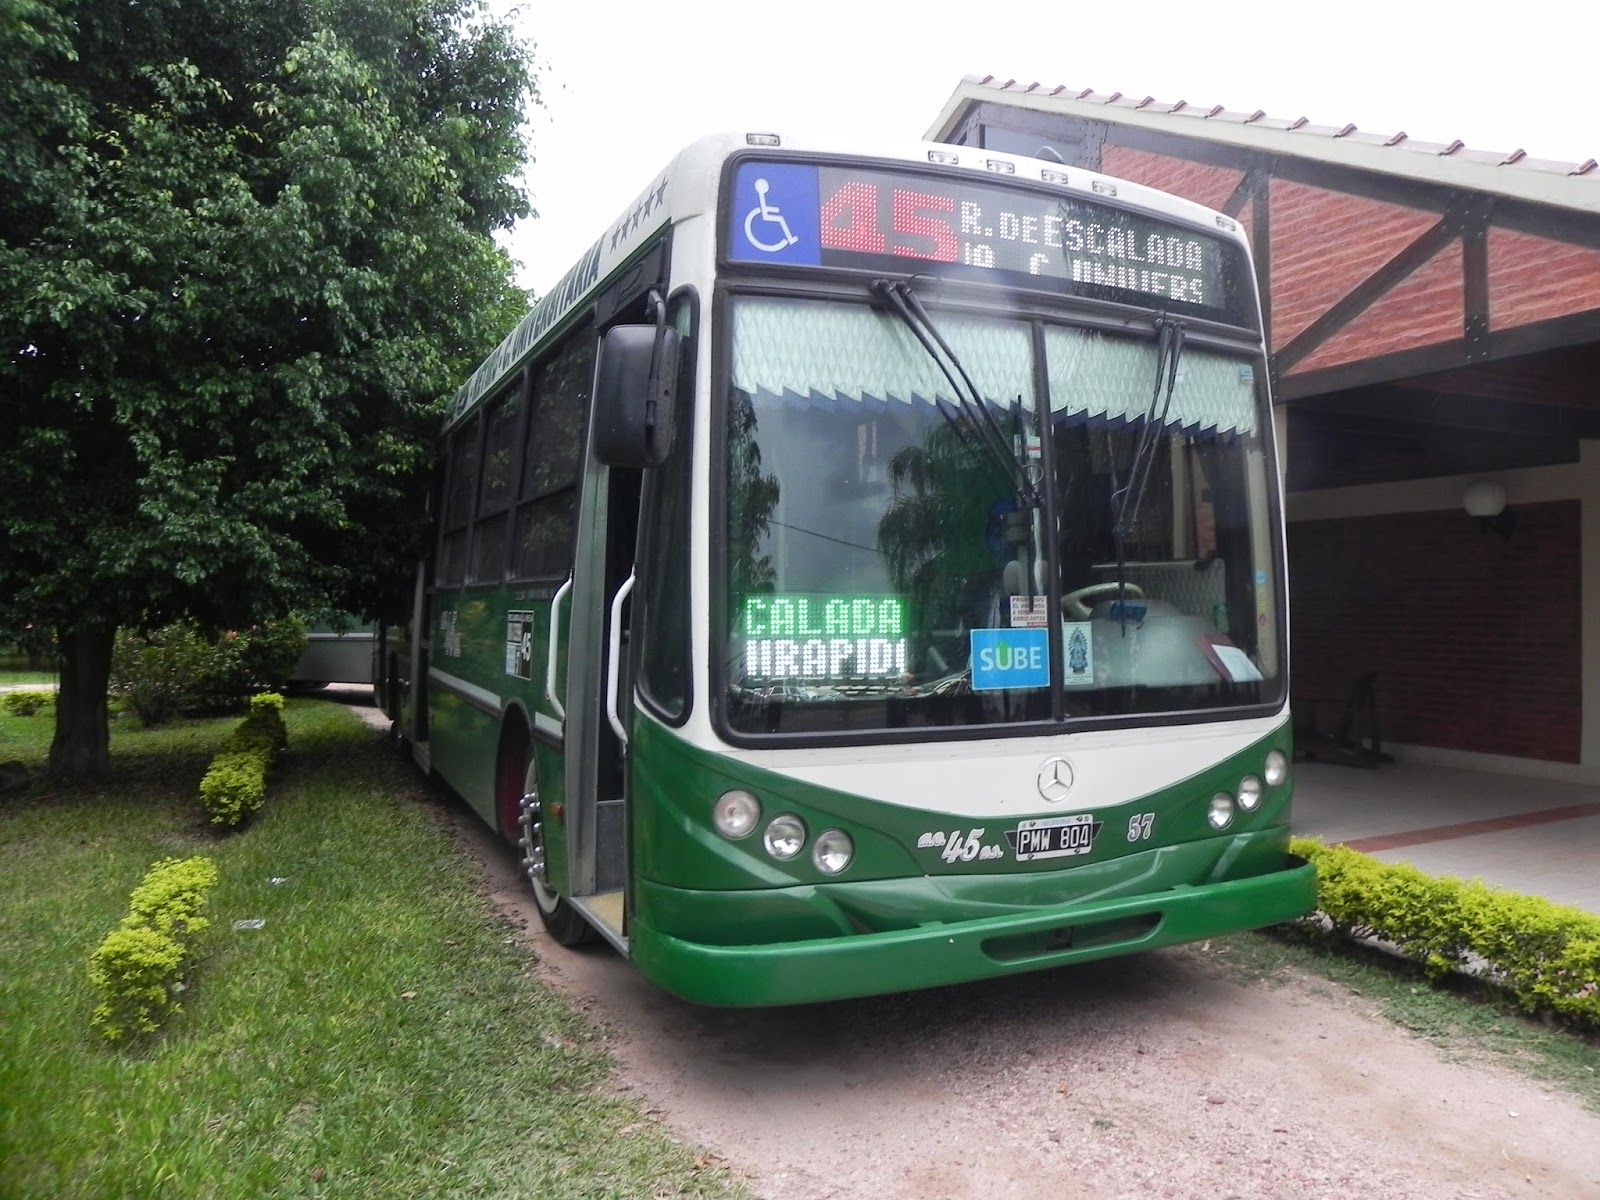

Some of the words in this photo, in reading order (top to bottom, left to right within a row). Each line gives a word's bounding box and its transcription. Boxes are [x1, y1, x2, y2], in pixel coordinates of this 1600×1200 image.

[820, 181, 958, 263] 45
[746, 598, 902, 635] CALADA
[980, 645, 1042, 671] SUBE
[1020, 829, 1051, 854] PMW
[1060, 824, 1089, 849] 804
[1127, 812, 1155, 842] 57
[941, 828, 985, 864] 45
